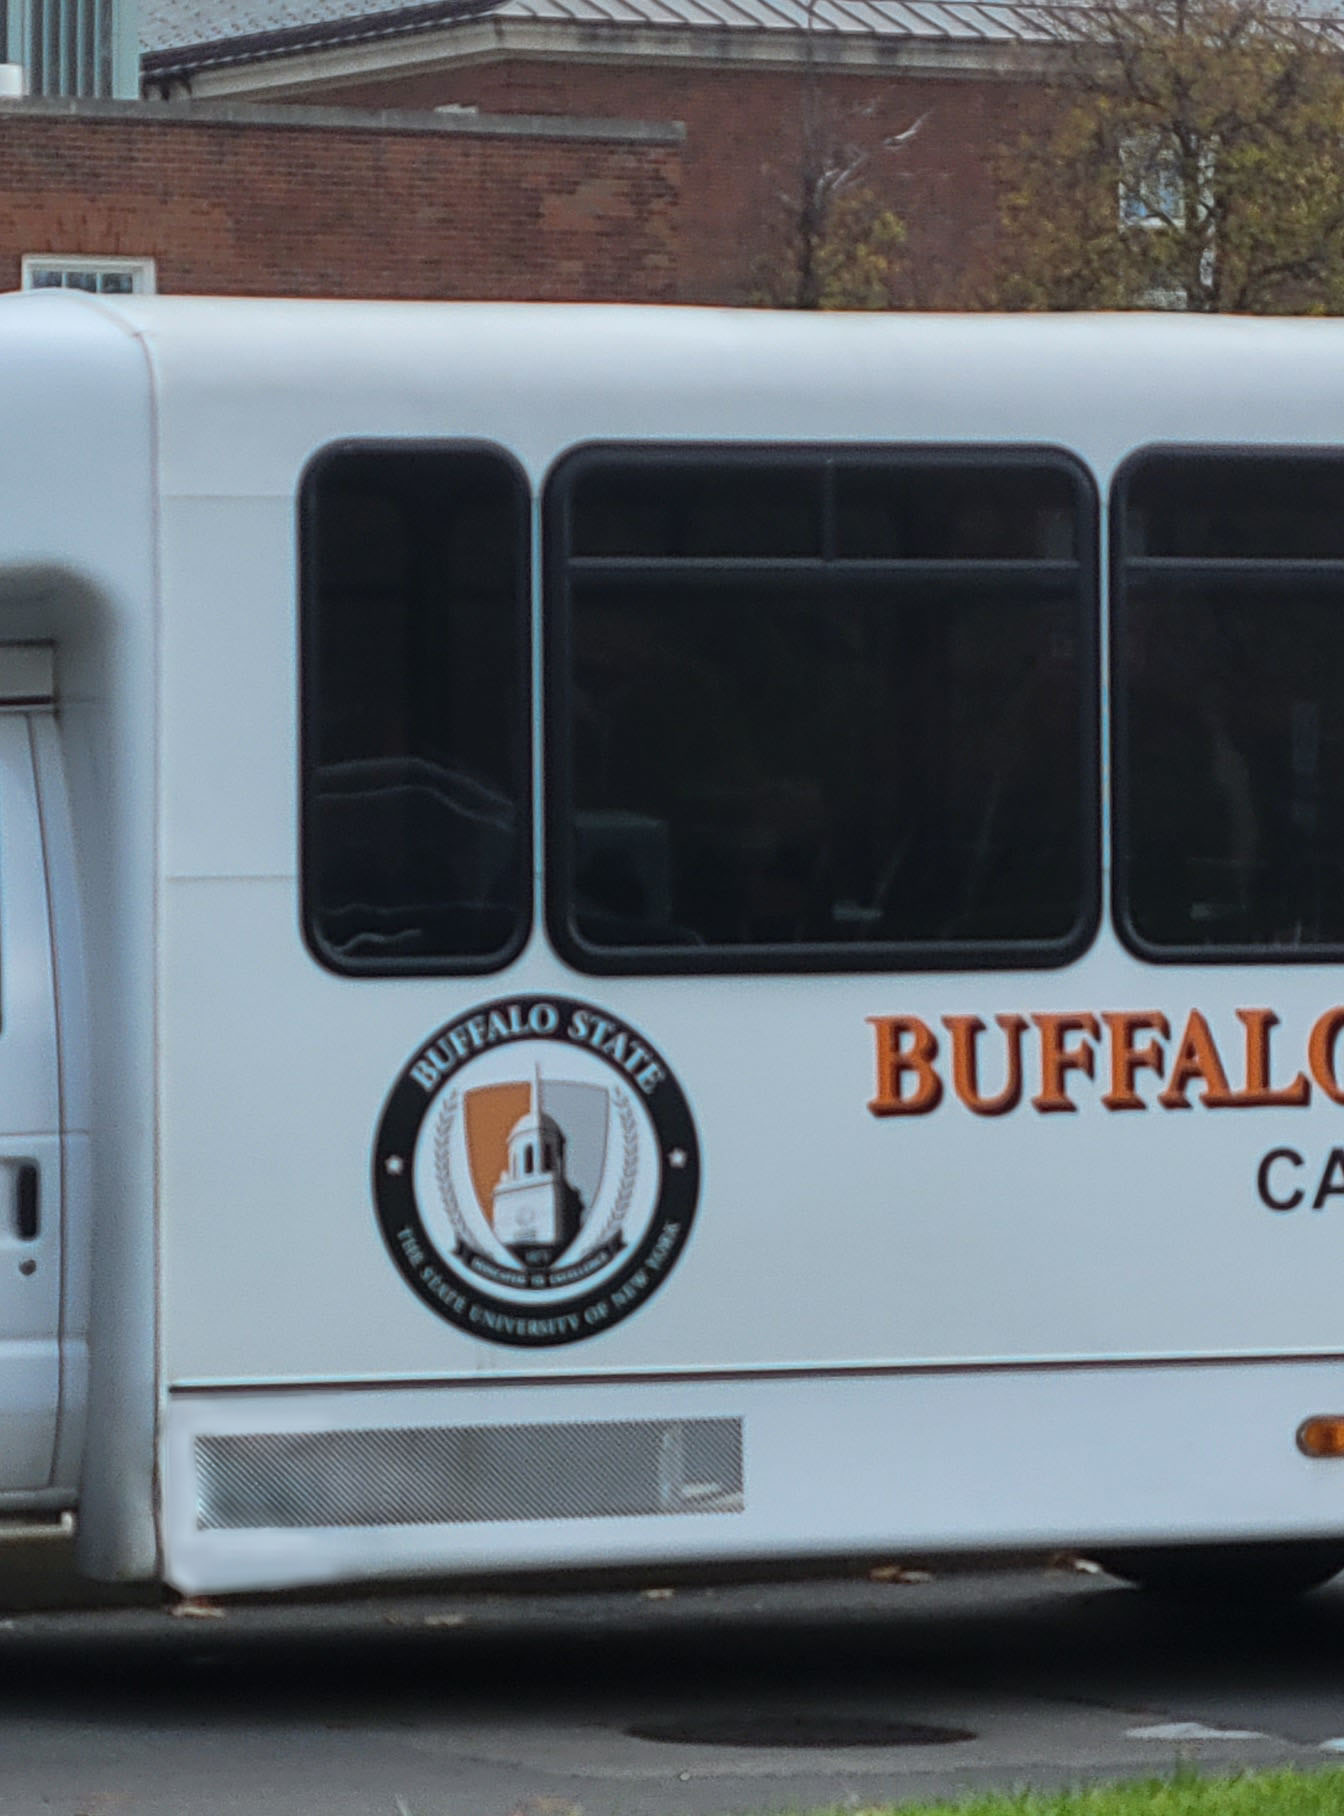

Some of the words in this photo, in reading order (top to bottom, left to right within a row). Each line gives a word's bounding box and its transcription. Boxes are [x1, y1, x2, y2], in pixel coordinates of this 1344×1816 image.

[410, 1003, 558, 1093] BUFFALO
[567, 1009, 666, 1095] STATE
[398, 1226, 426, 1268] THE
[419, 1264, 467, 1314] STATE
[468, 1304, 582, 1338] UNIVERSITY
[583, 1301, 609, 1327] OF
[610, 1269, 650, 1309] NEW
[644, 1221, 682, 1271] YORK
